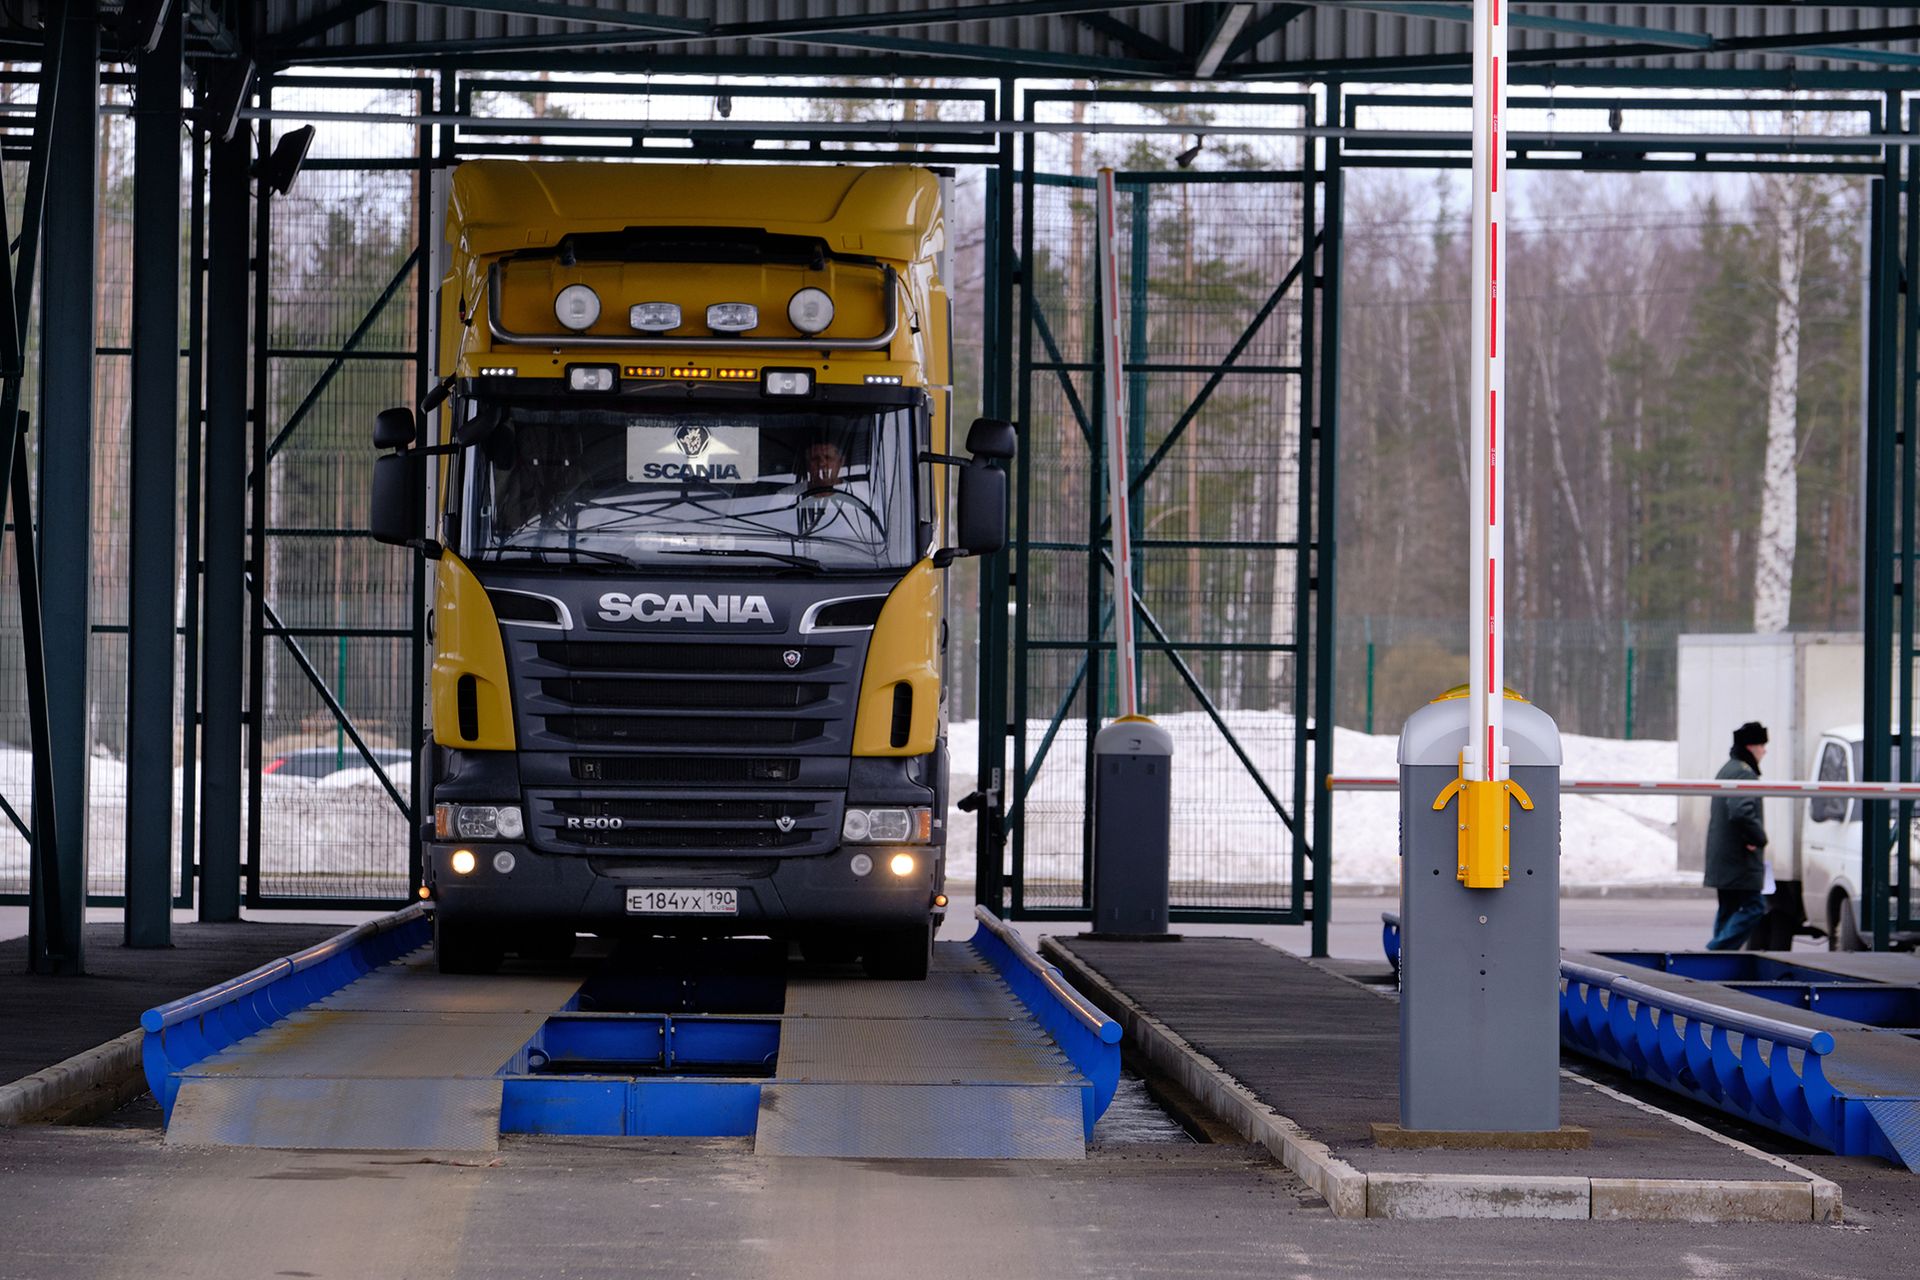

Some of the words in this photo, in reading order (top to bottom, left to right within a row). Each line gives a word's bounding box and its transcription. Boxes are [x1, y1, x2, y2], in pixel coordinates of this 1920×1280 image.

[643, 462, 741, 480] SCANIA
[598, 592, 774, 623] SCANIA
[567, 817, 580, 829] R
[583, 817, 622, 829] 500
[706, 891, 733, 905] 190
